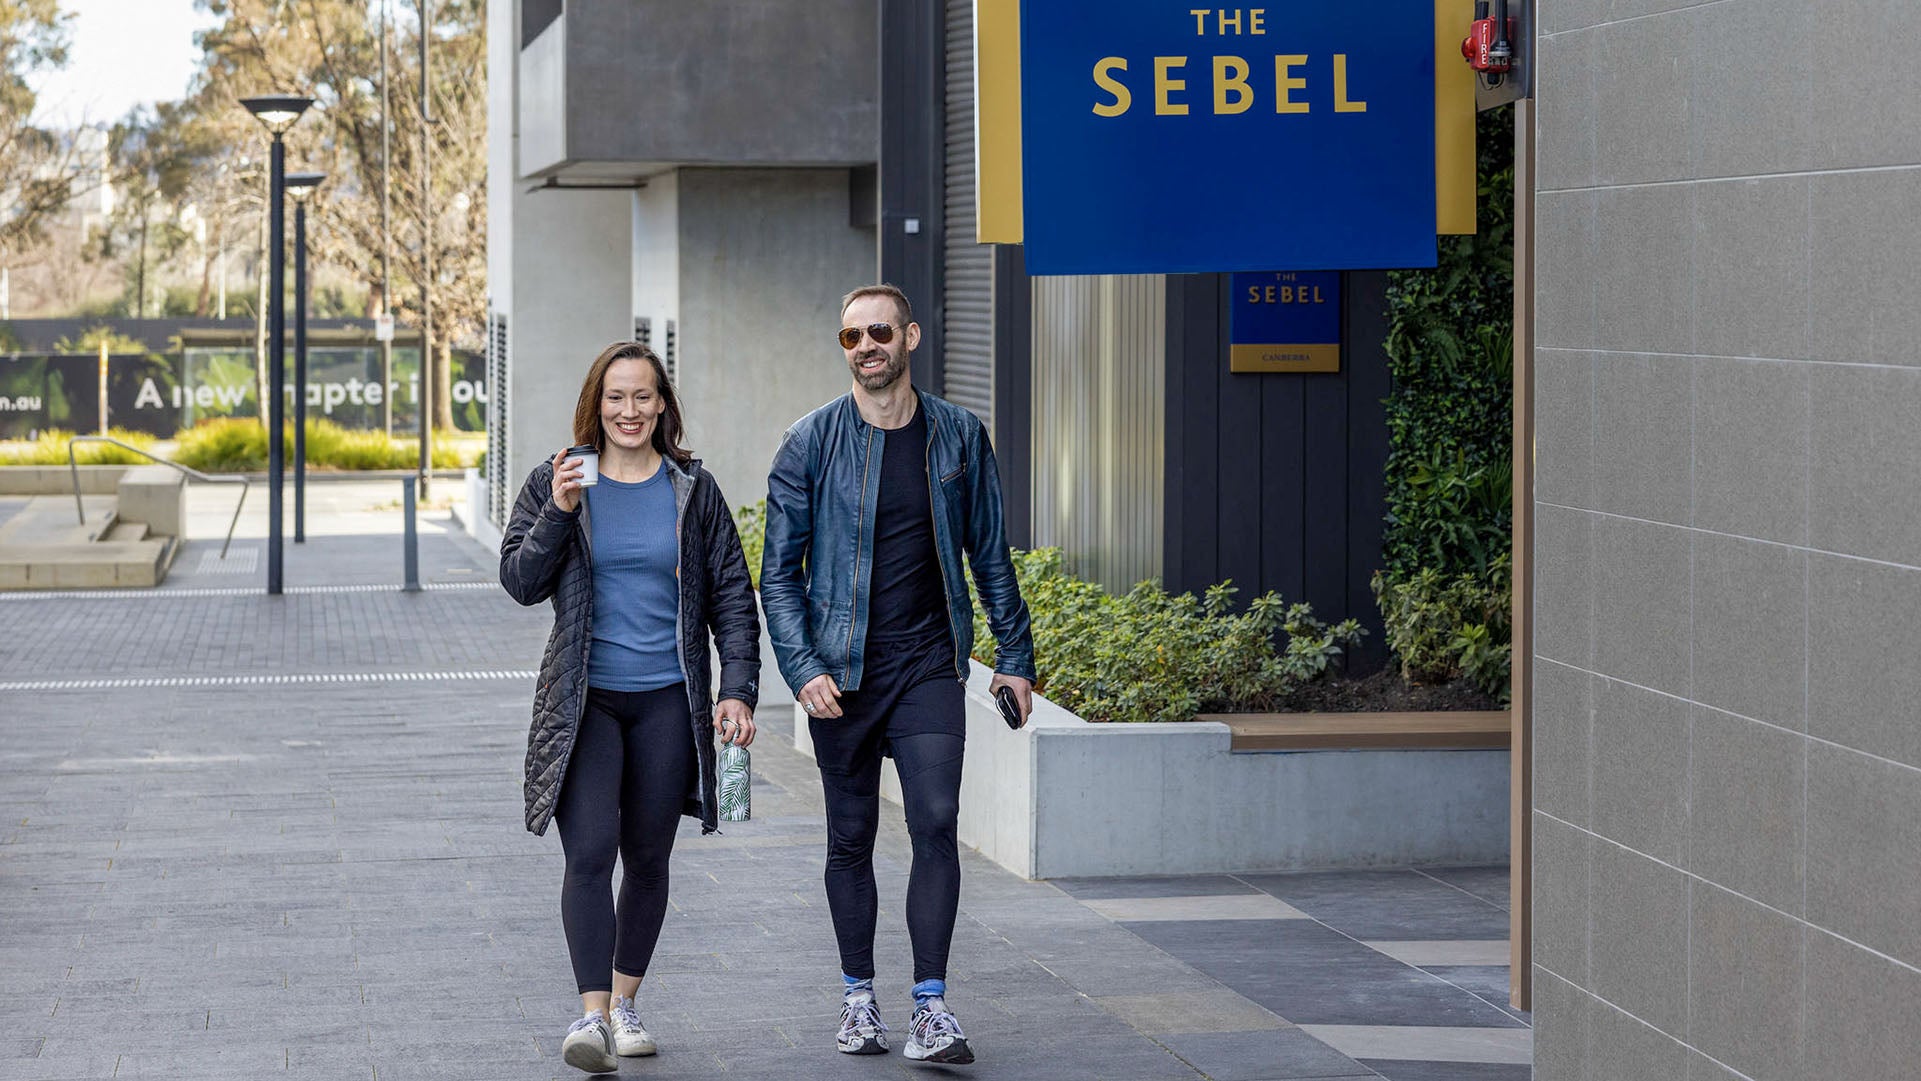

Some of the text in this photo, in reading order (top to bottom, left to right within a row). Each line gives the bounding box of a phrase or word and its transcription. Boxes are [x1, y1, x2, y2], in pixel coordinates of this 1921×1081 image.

[1190, 9, 1266, 35] THE
[1092, 54, 1367, 117] SEBEL
[1276, 272, 1296, 281] THE
[1248, 285, 1324, 303] SEBEL
[134, 377, 164, 409] A
[171, 384, 247, 408] new
